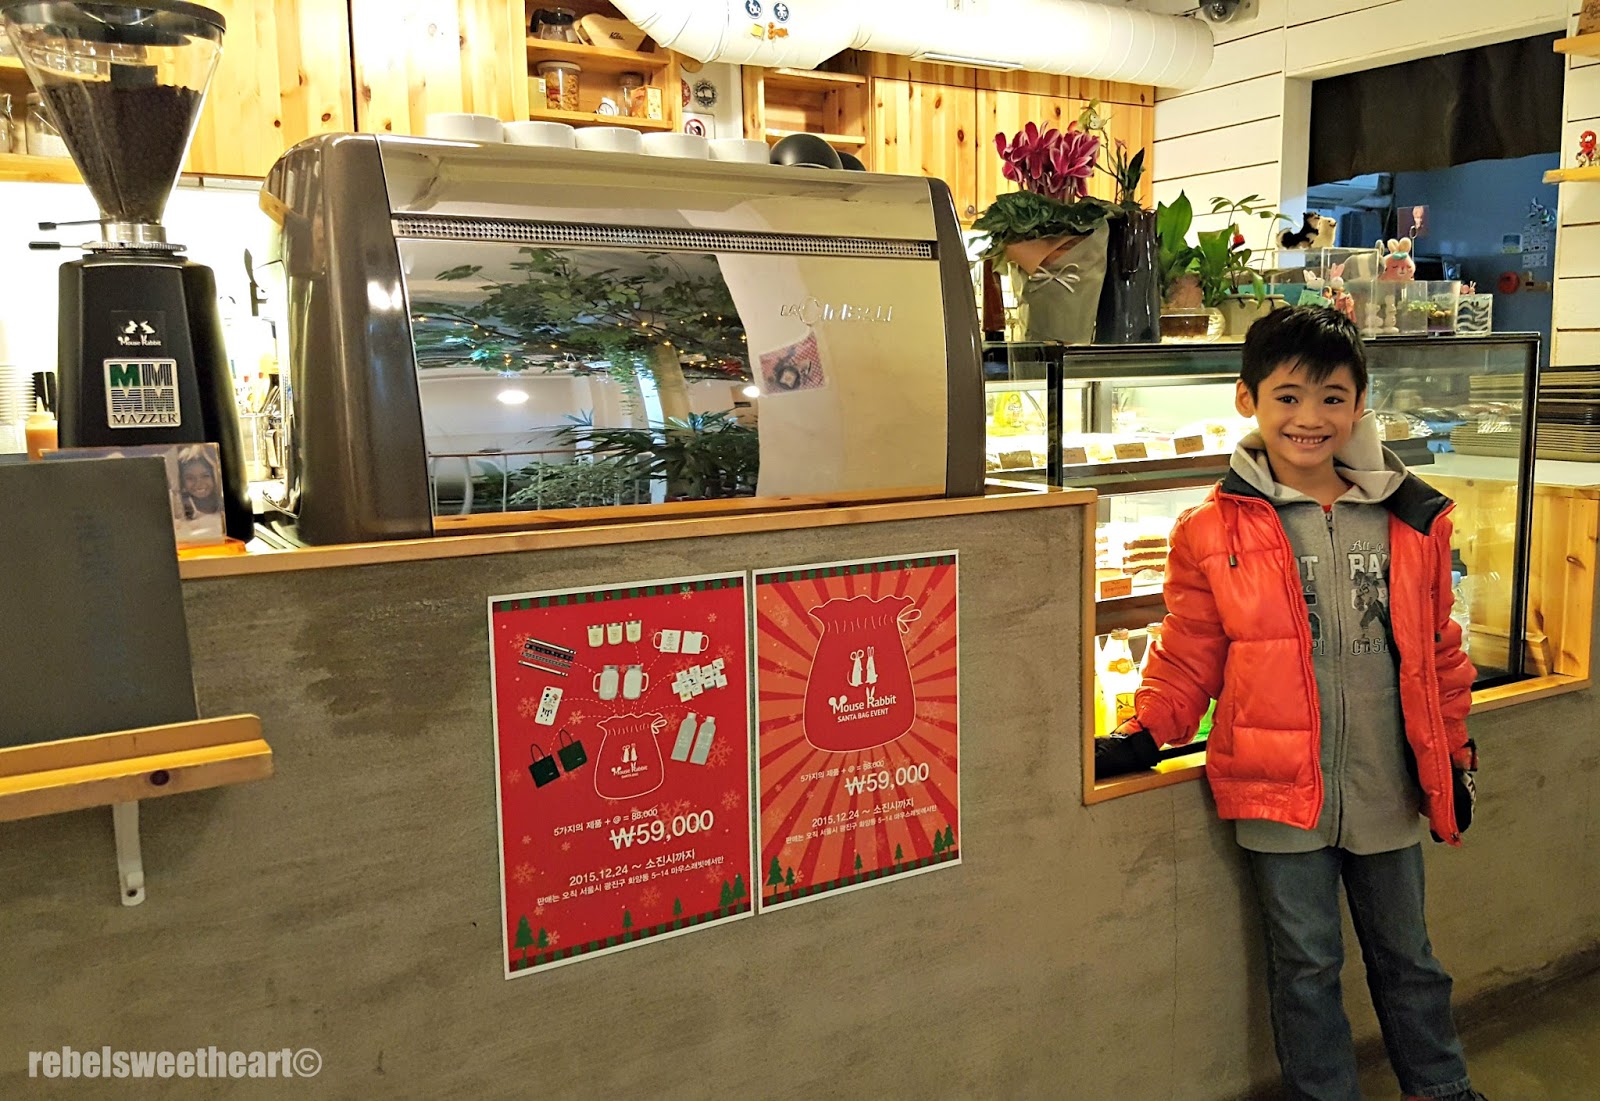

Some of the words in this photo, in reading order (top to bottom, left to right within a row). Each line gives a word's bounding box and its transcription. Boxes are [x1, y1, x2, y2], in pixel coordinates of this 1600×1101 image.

[112, 413, 178, 425] MAZZER
[828, 695, 865, 715] Mouse
[866, 686, 897, 709] Rabbit
[837, 714, 857, 723] SANTA
[857, 711, 870, 720] BAG
[870, 707, 889, 718] EVENT
[811, 810, 860, 828] 2015.12.24
[873, 797, 914, 815] 소진시까지
[569, 864, 629, 886] 2015.12.24
[645, 848, 696, 869] 소진시까지
[579, 883, 602, 896] 서울시
